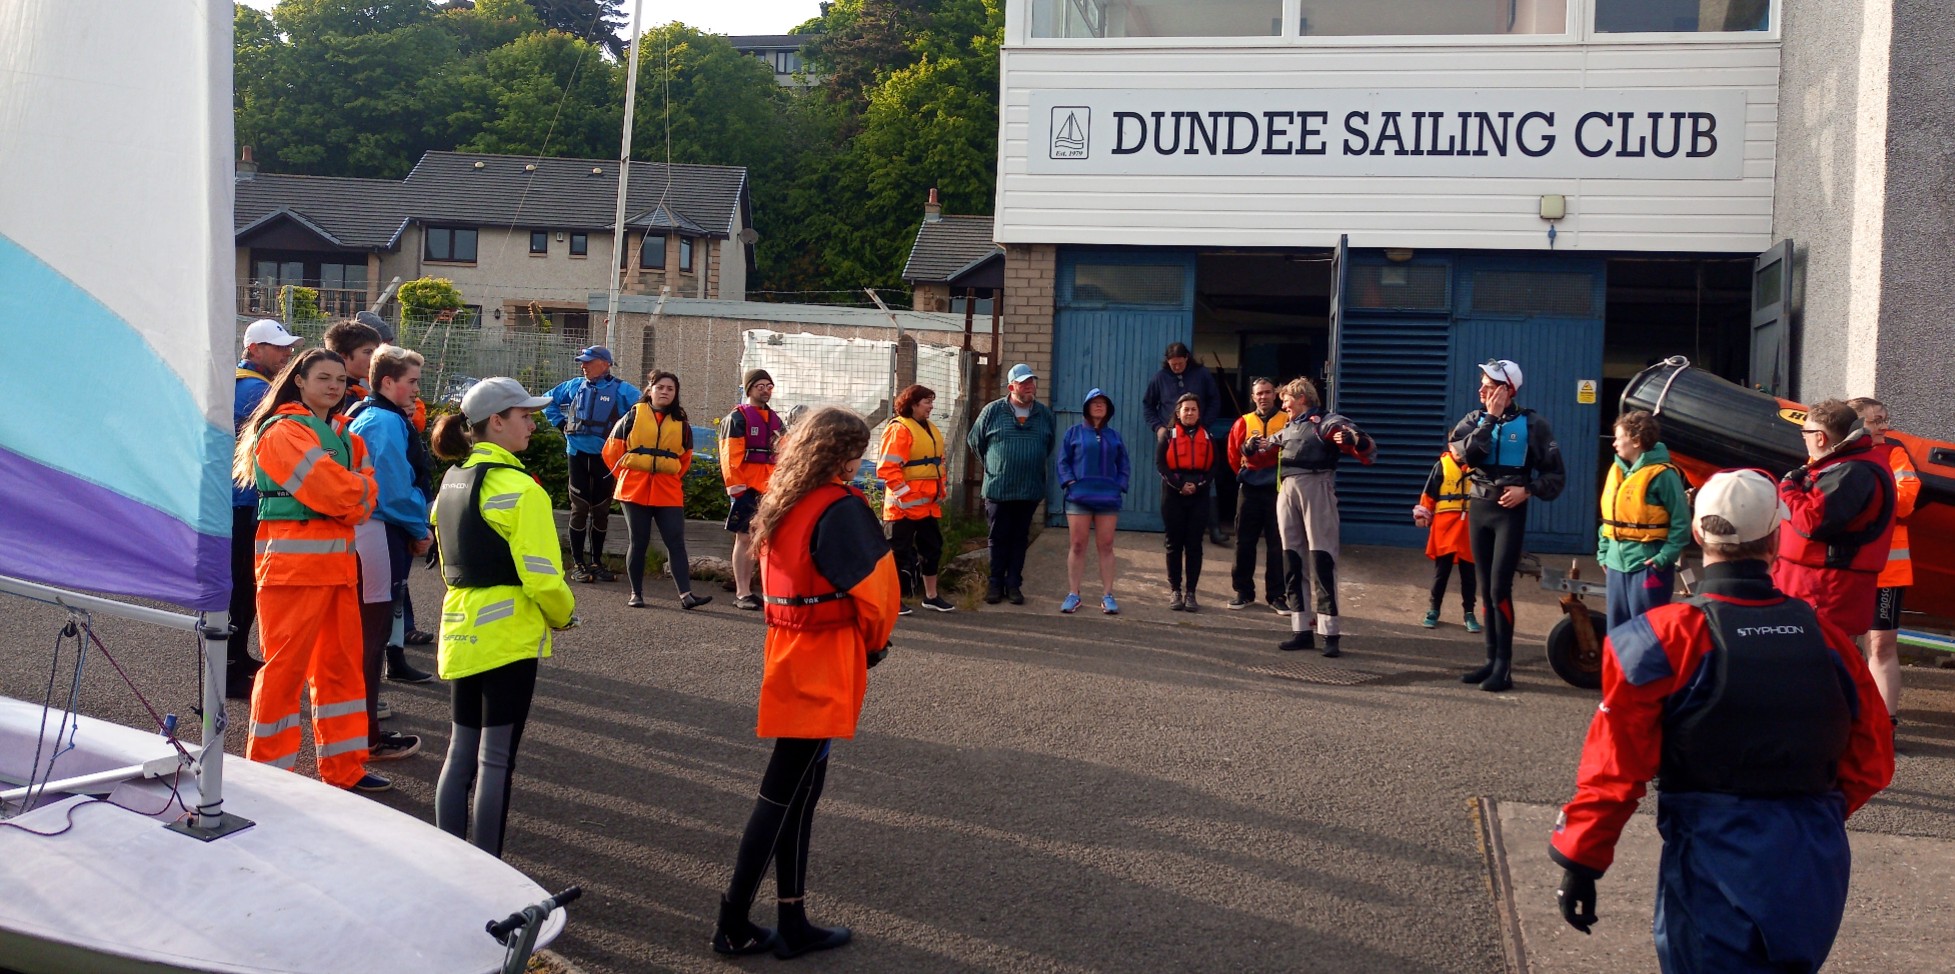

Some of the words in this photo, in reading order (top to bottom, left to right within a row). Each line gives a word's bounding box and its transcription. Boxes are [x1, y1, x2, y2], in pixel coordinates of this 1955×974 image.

[1111, 111, 1328, 155] DUNDEE
[1343, 111, 1556, 157] SAILING
[1574, 111, 1718, 158] CLUB
[1743, 625, 1805, 636] TYPHOON
